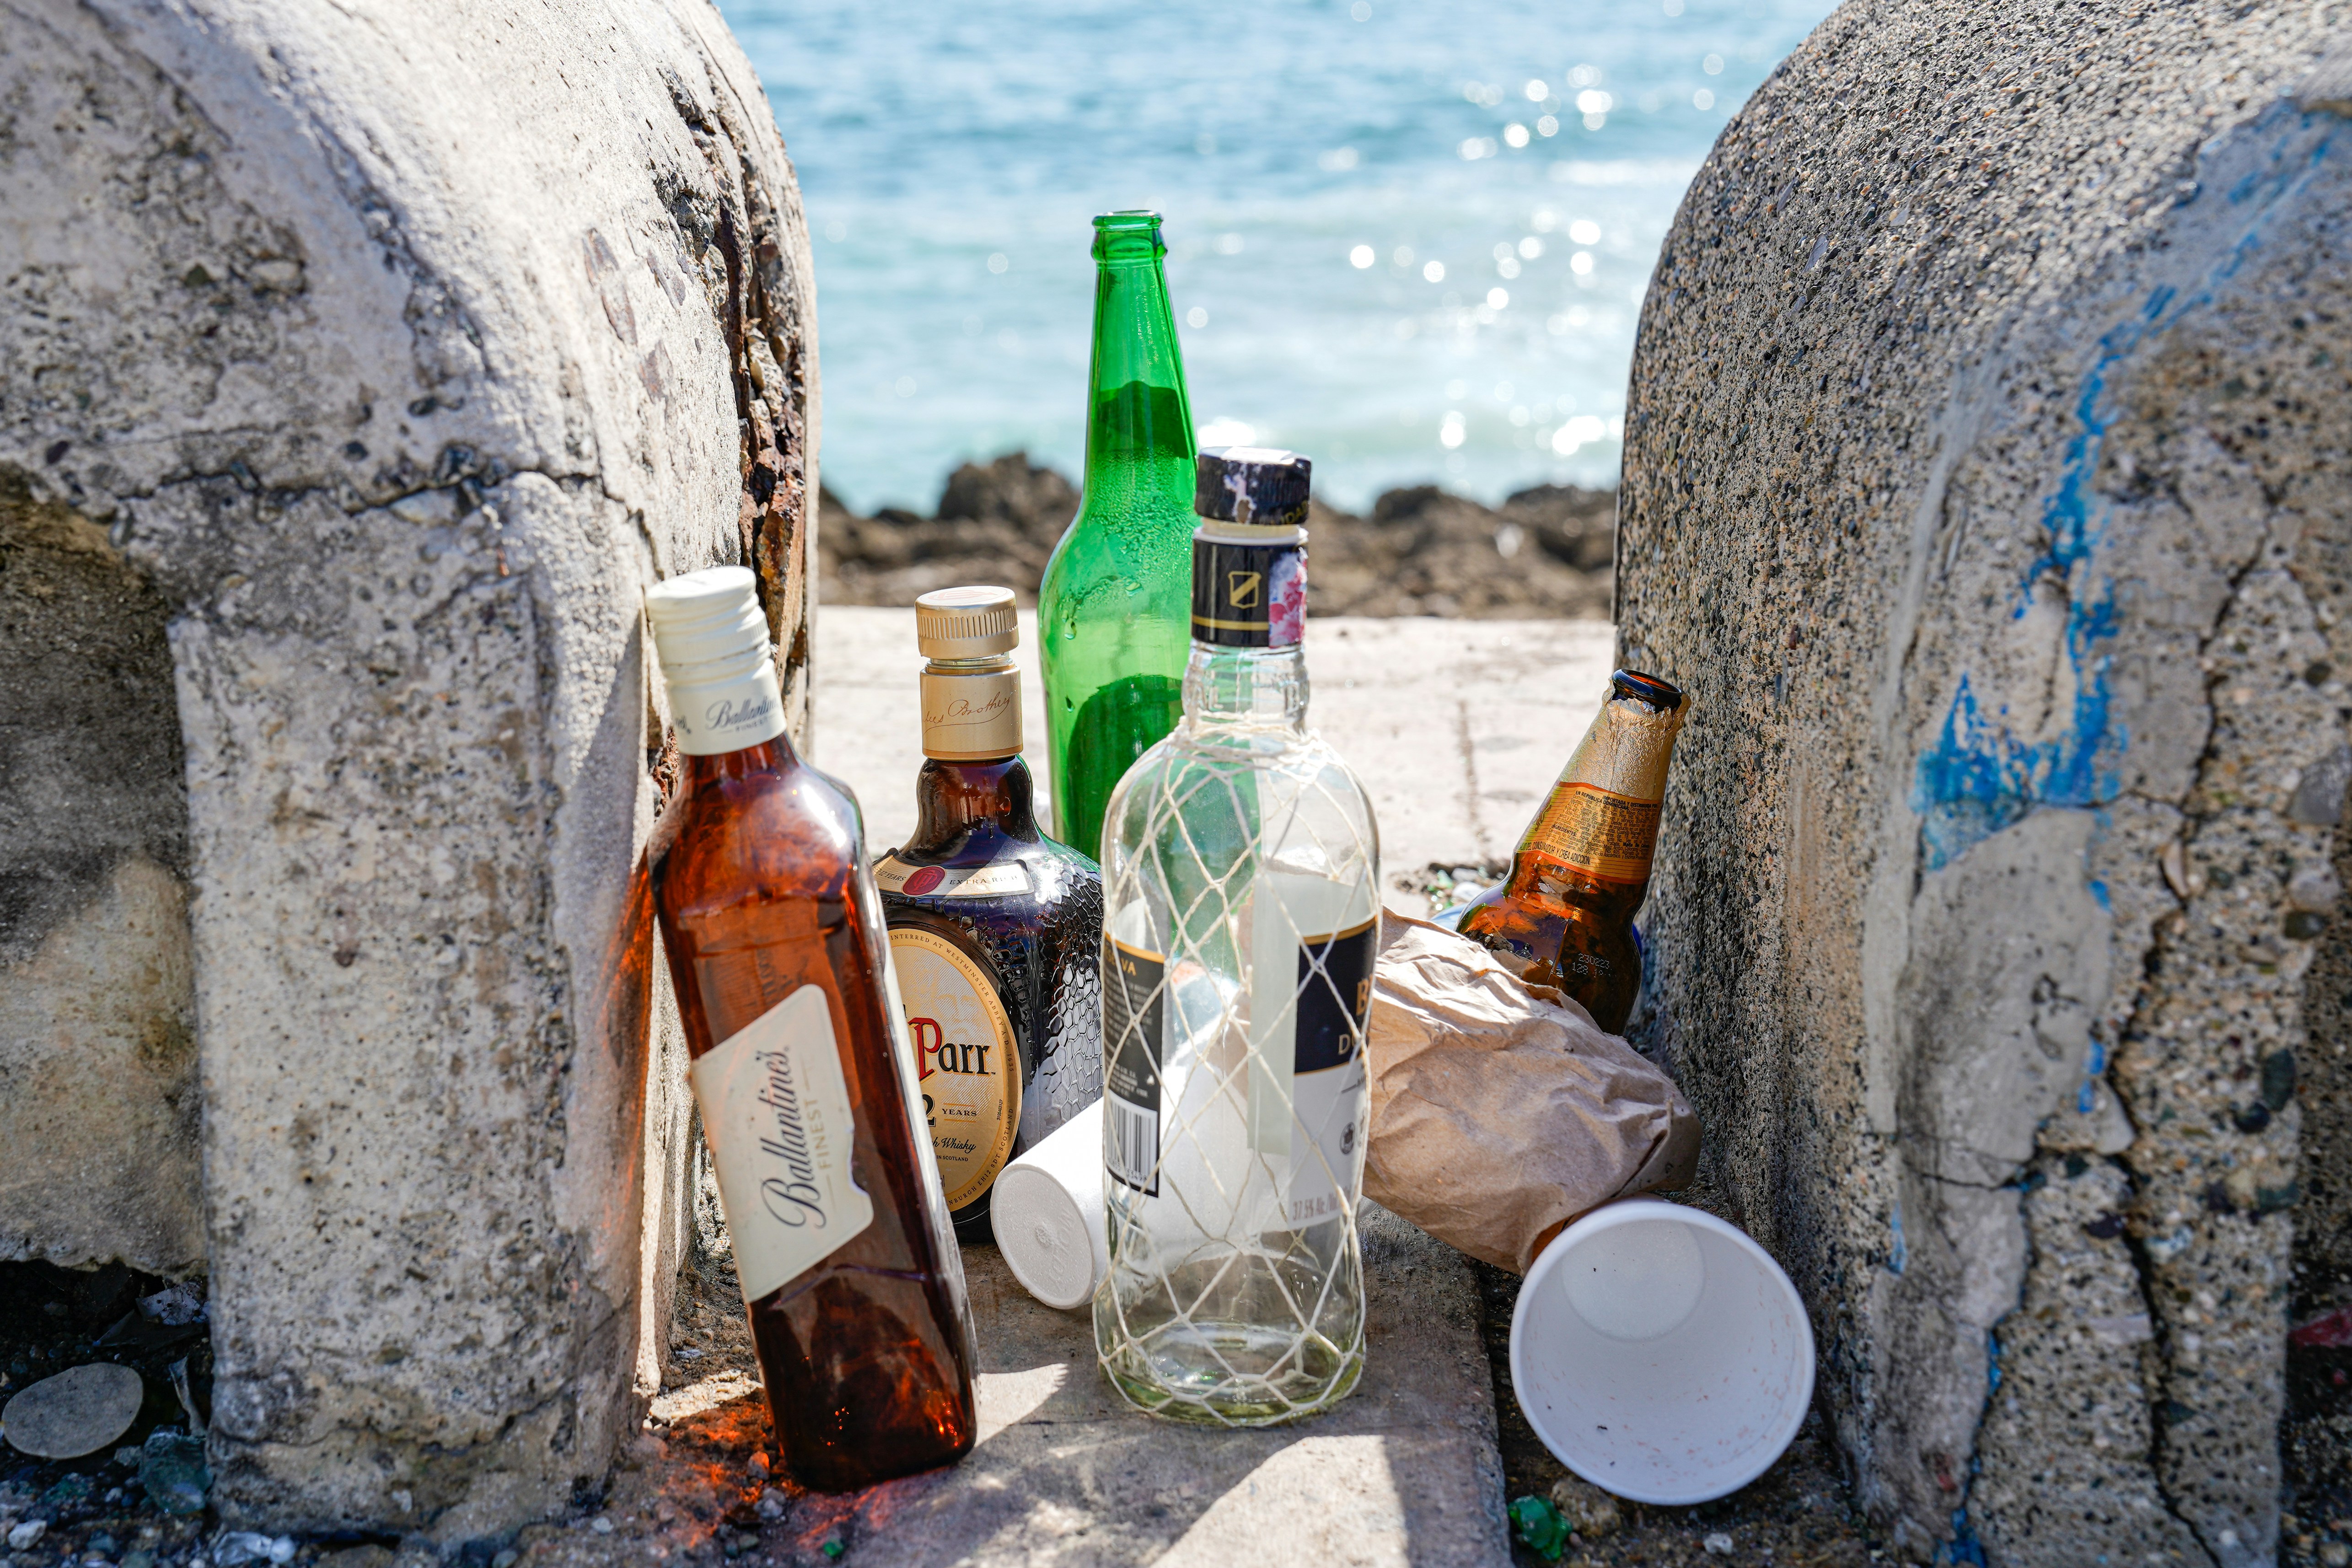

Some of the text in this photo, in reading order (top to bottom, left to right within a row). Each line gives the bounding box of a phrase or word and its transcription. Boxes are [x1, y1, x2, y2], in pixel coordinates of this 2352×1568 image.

[948, 691, 1010, 717] Brothers
[1603, 795, 1626, 805] IMPORTADA
[1559, 849, 1570, 859] CREA
[885, 873, 906, 881] YEARS
[1578, 953, 1610, 969] 230223
[891, 934, 929, 943] INTERRED
[946, 948, 989, 996] WESTMINSTER
[988, 1000, 1004, 1026] ABBEY
[908, 1017, 990, 1082] Parr
[942, 1108, 977, 1117] YEARS
[760, 1050, 826, 1229] Ballantine's
[804, 1099, 832, 1170] FINEST
[941, 1137, 977, 1154] Whisky
[948, 1109, 1013, 1205] NBURGH EH12 9DT SCOTLAND
